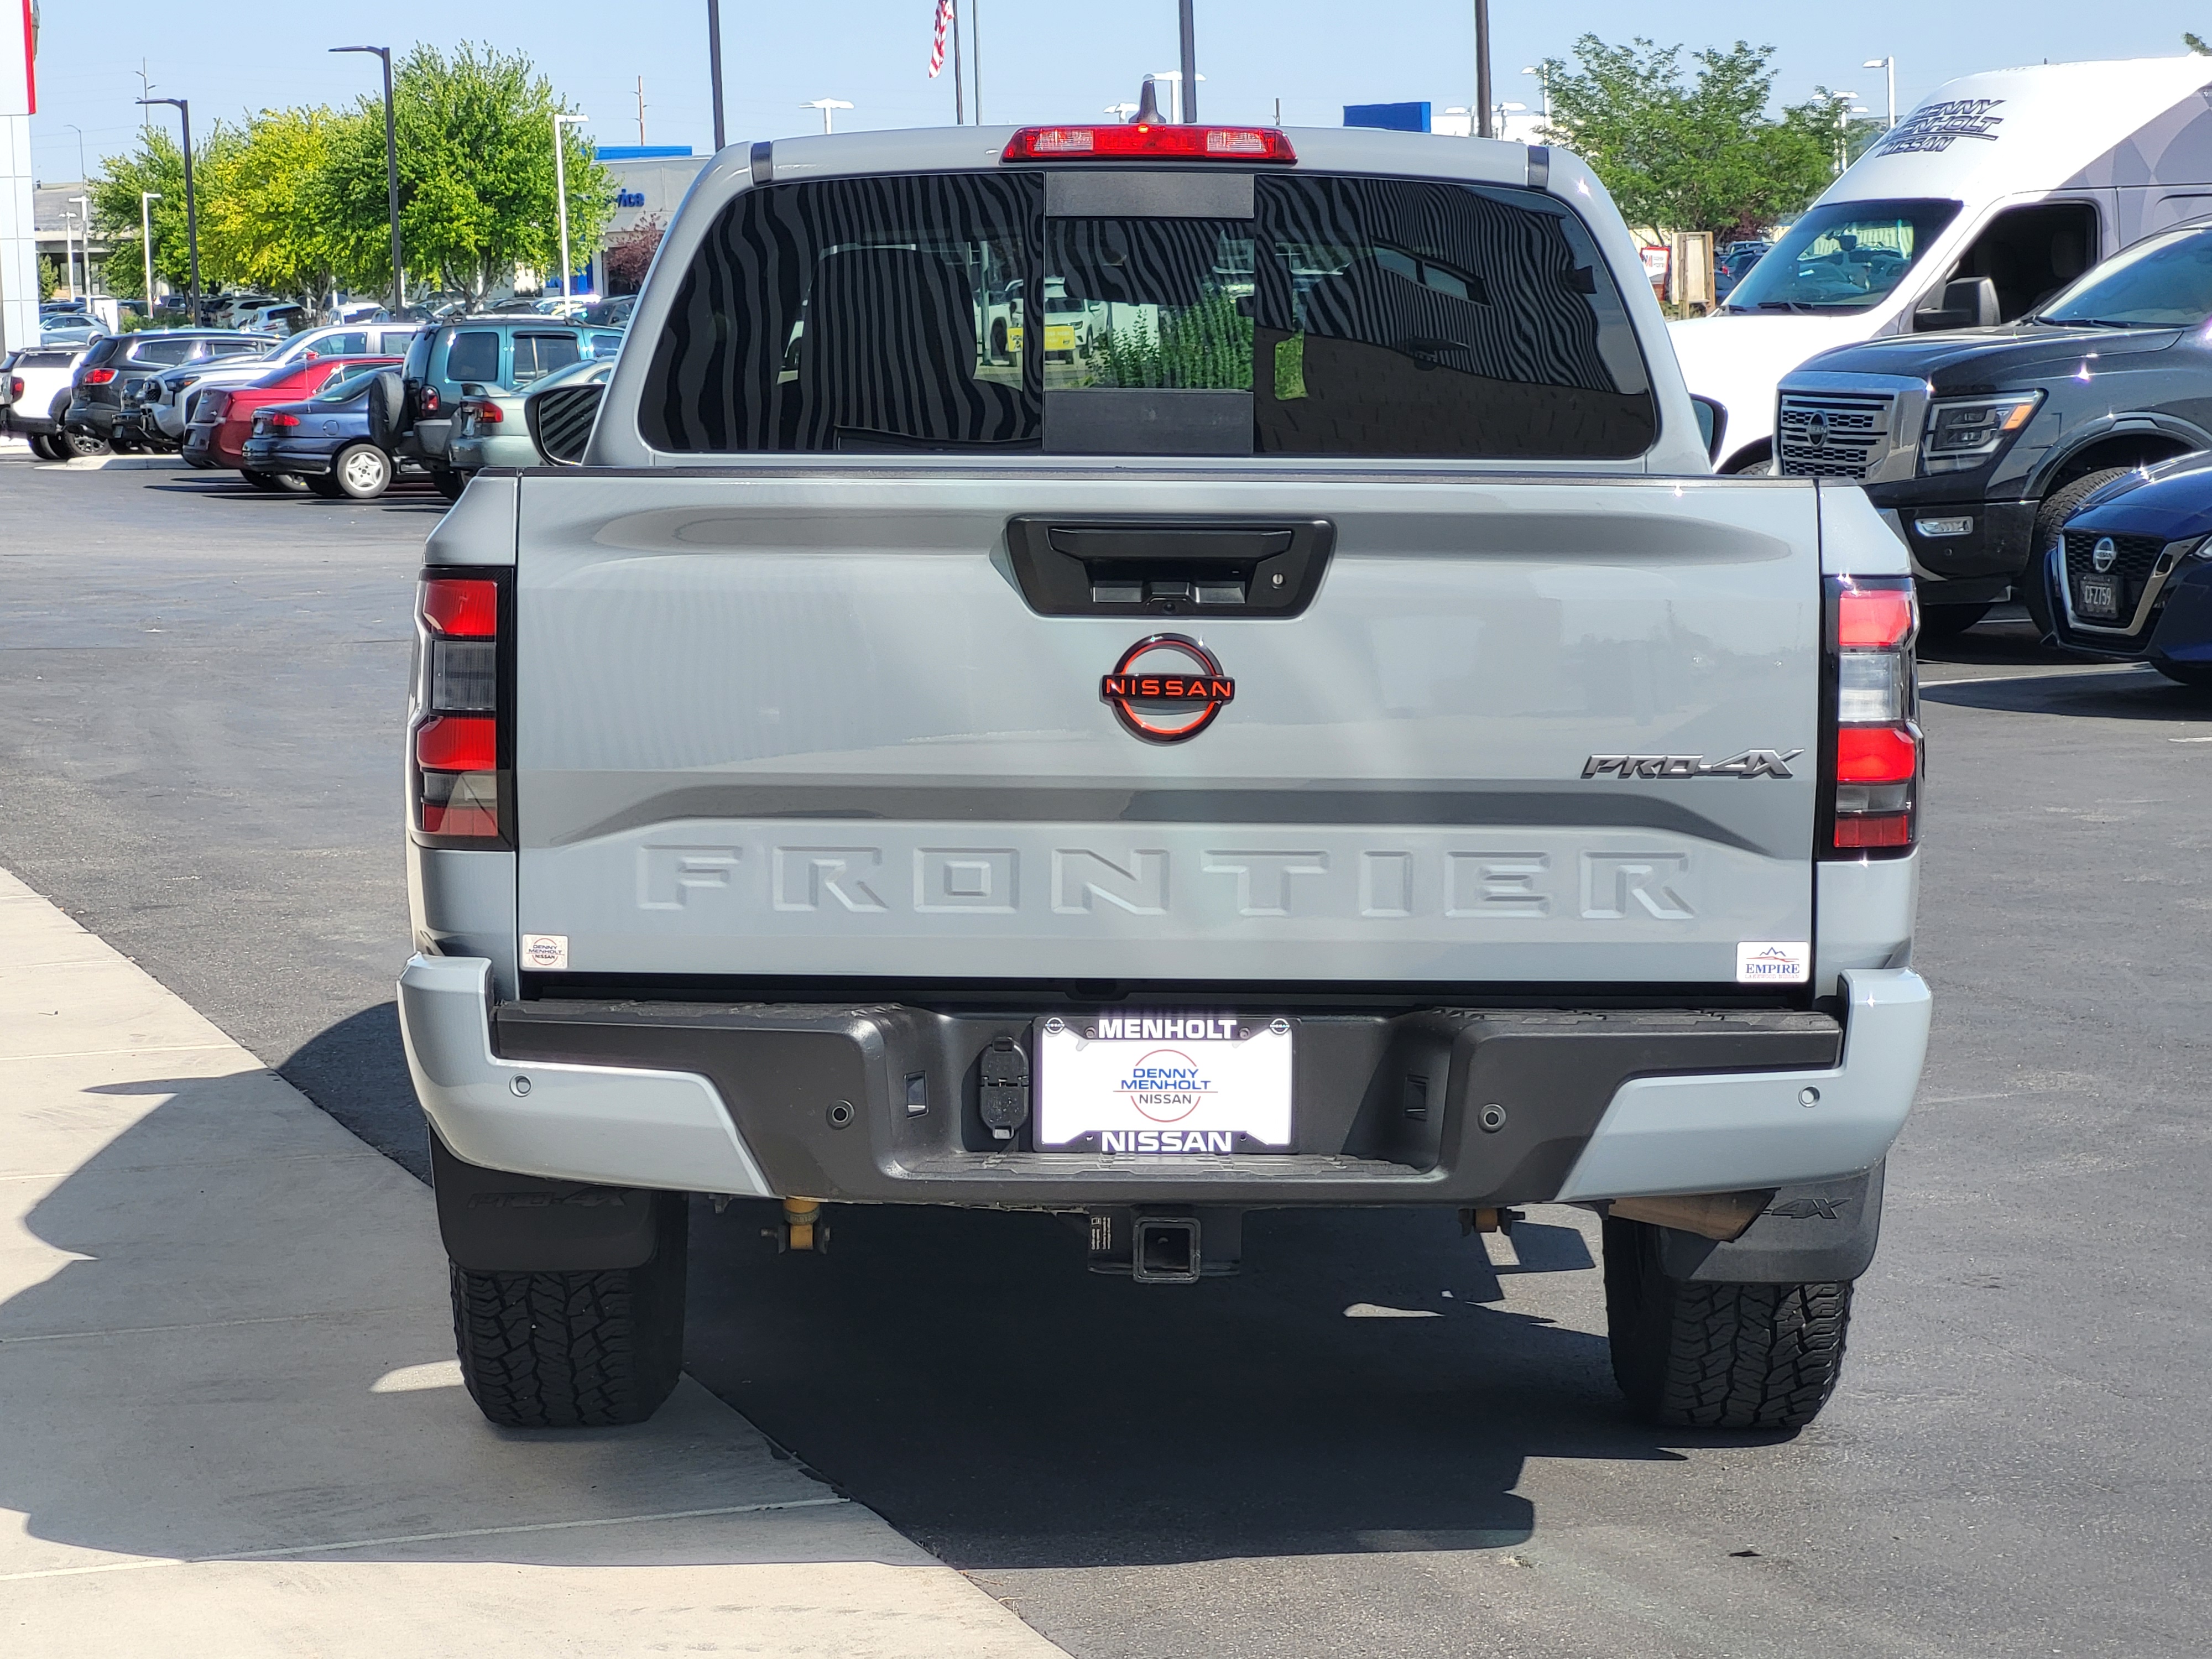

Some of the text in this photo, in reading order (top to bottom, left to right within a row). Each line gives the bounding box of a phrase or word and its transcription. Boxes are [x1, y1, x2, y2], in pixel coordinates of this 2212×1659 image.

[1907, 99, 2007, 123] DENNY
[1884, 115, 2005, 140] MENHOLT
[1874, 136, 1957, 159] NISSAN
[1106, 679, 1231, 697] NISSAN
[1580, 748, 1806, 779] PRO-4X
[636, 844, 1697, 919] FRONTIER
[1745, 963, 1800, 974] EMPIRE
[1098, 1019, 1237, 1040] MENHOLT
[1133, 1068, 1199, 1078] DENNY
[1120, 1079, 1212, 1090] MENHOLT
[1139, 1094, 1192, 1104] NISSAN
[1101, 1131, 1232, 1152] NISSAN
